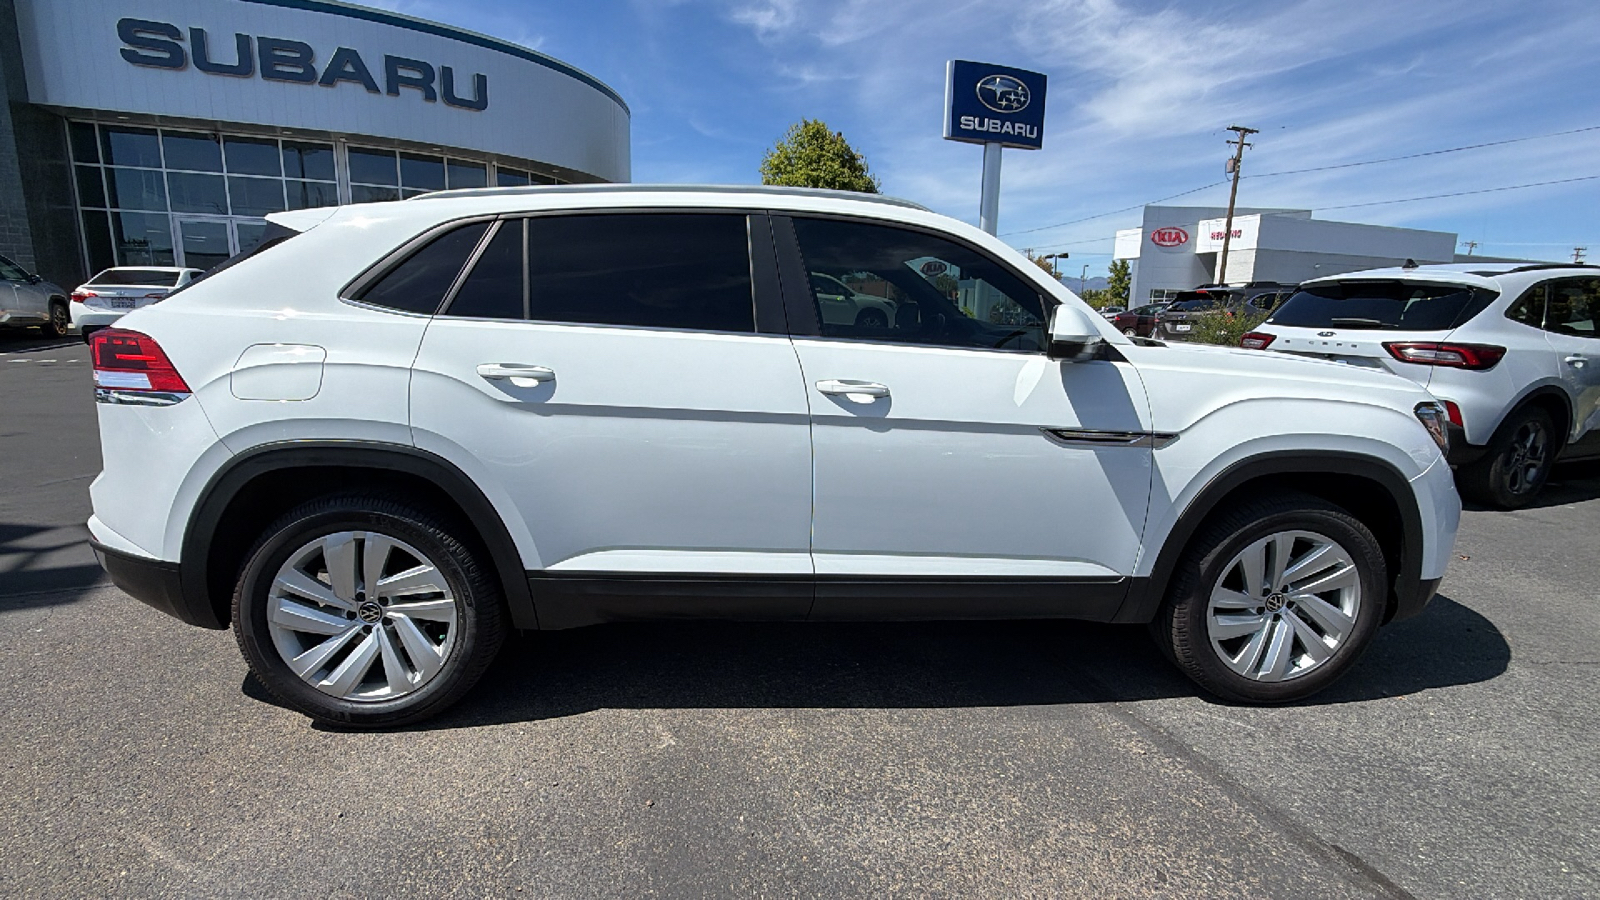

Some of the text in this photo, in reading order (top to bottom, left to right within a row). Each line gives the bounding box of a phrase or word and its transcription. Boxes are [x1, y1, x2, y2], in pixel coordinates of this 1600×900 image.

[117, 18, 488, 111] SUBARU
[960, 116, 1037, 138] SUBARU
[1156, 230, 1185, 243] KIA
[923, 262, 946, 274] KIA
